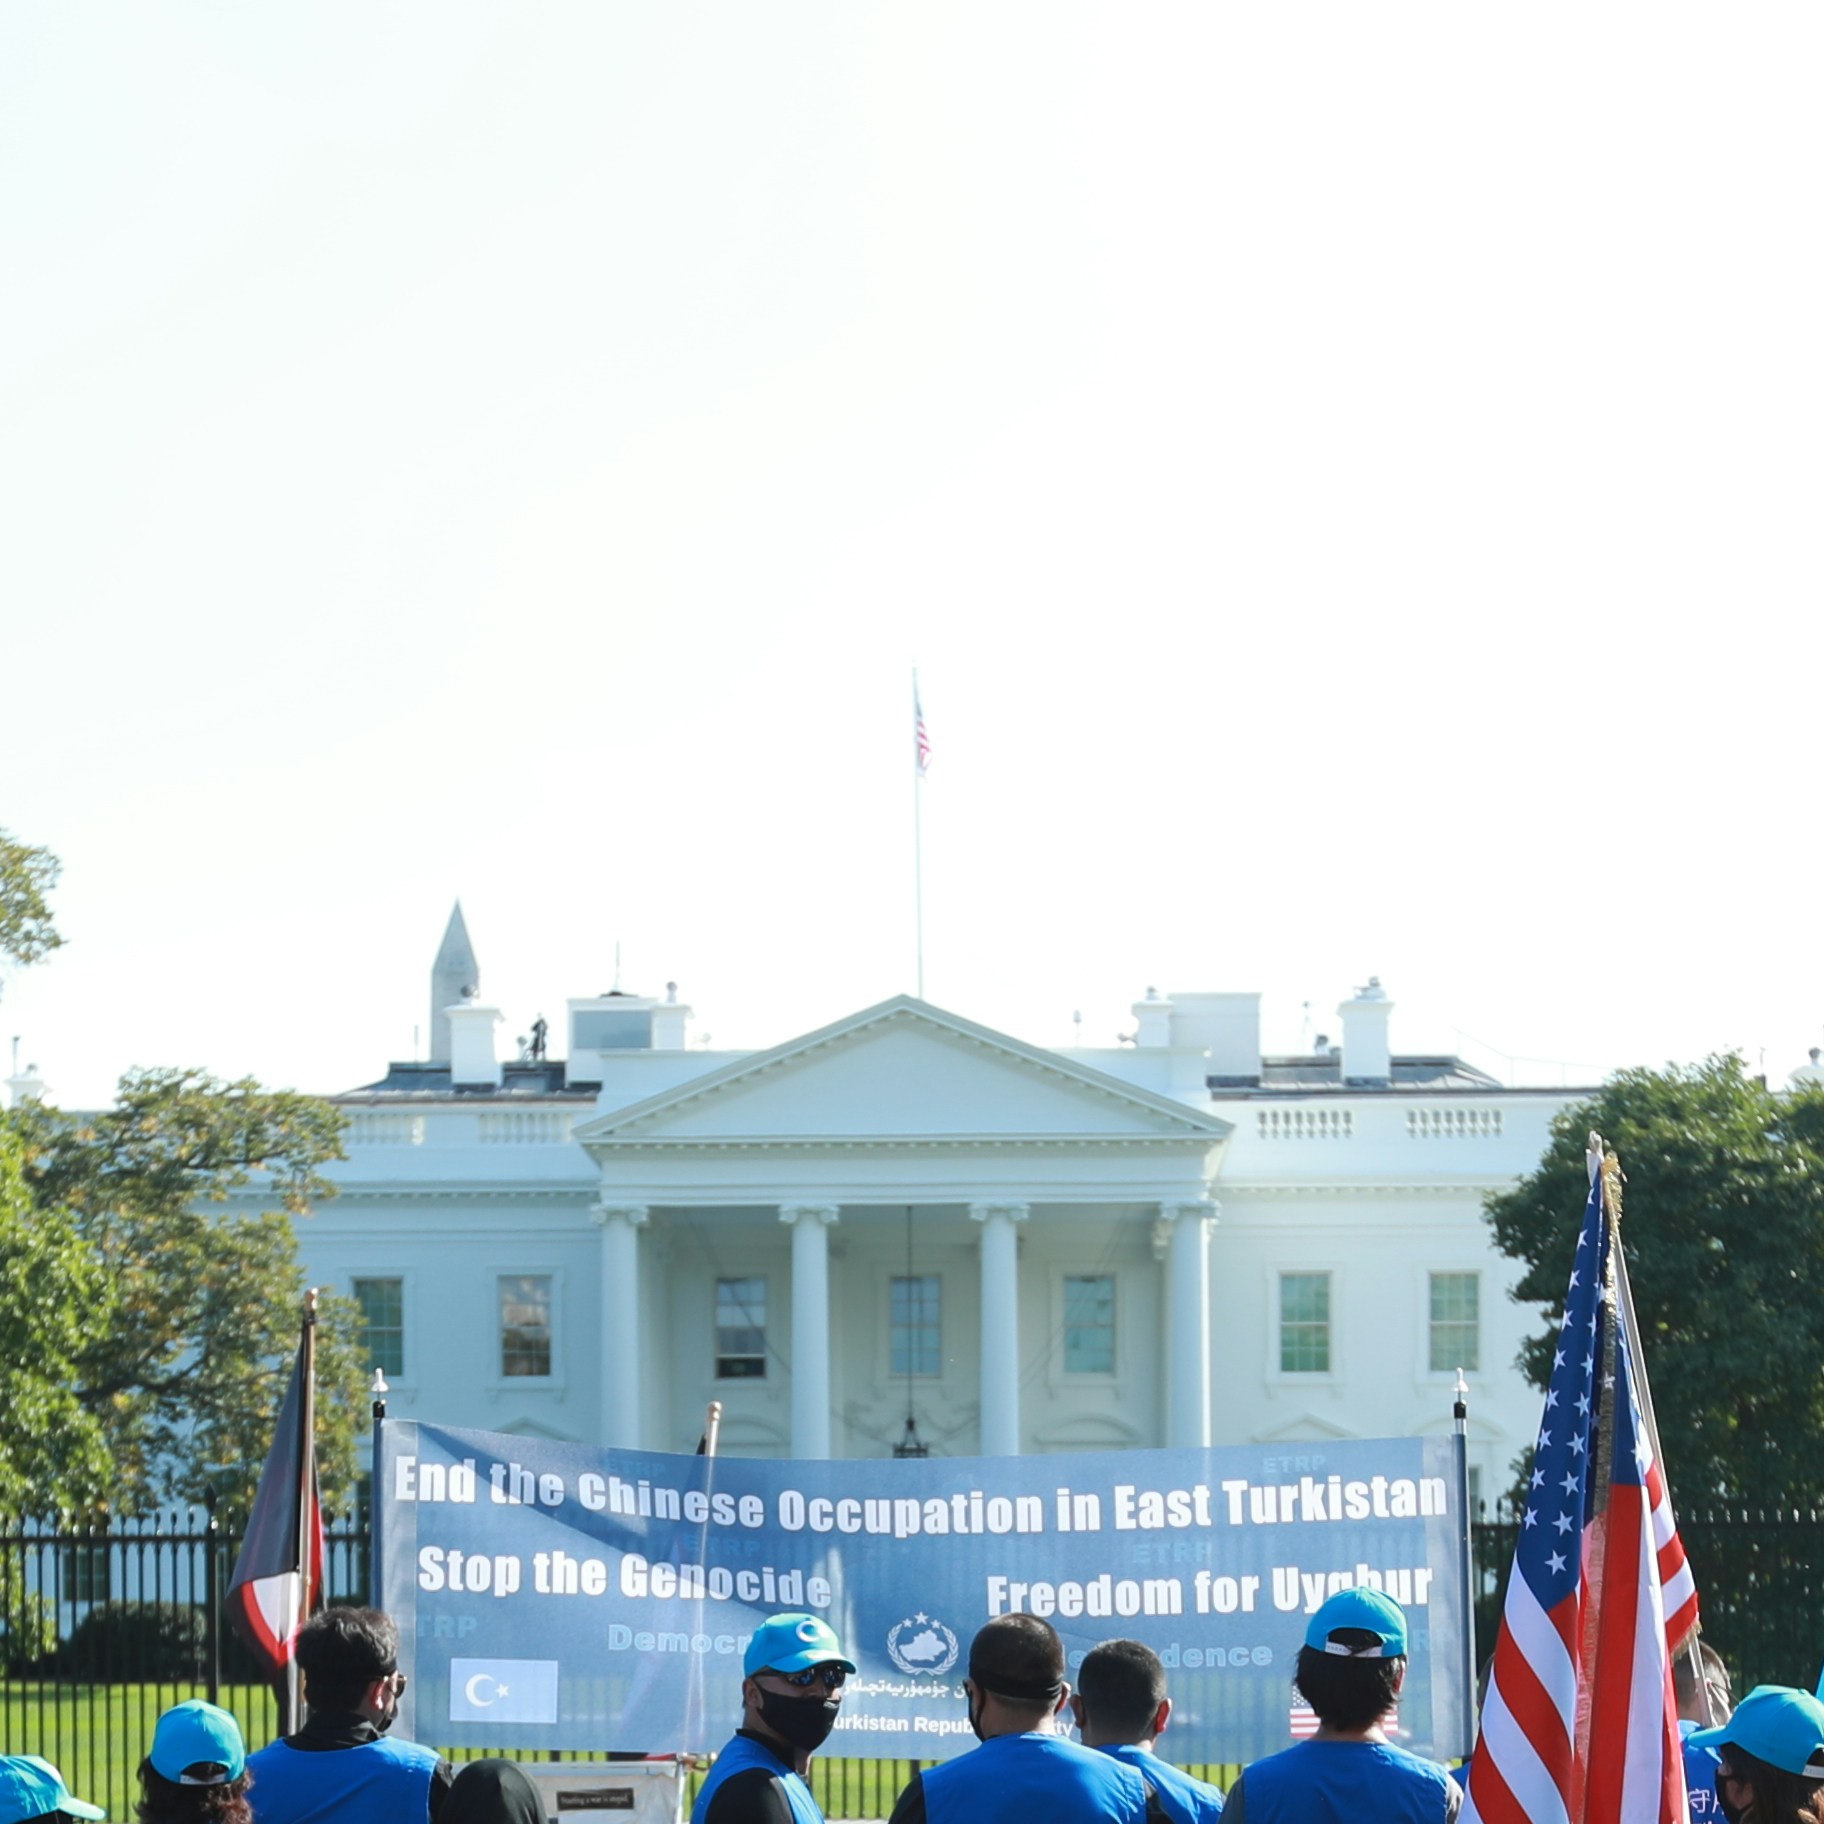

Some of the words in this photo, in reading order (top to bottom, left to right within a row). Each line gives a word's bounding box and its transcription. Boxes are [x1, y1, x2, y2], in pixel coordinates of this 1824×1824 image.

[395, 1455, 476, 1503] End
[490, 1462, 565, 1506] the
[578, 1472, 765, 1529] Chinese
[778, 1489, 1044, 1538] Occupation
[1056, 1487, 1102, 1532] in
[1114, 1483, 1212, 1530] East
[1222, 1475, 1447, 1525] Turkistan
[417, 1545, 521, 1597] Stop
[533, 1550, 607, 1597] the
[619, 1552, 832, 1609] Genocide
[986, 1573, 1183, 1618] Freedom
[1194, 1570, 1260, 1615] for
[607, 1623, 746, 1656] Democr
[833, 1716, 909, 1733] urkistan
